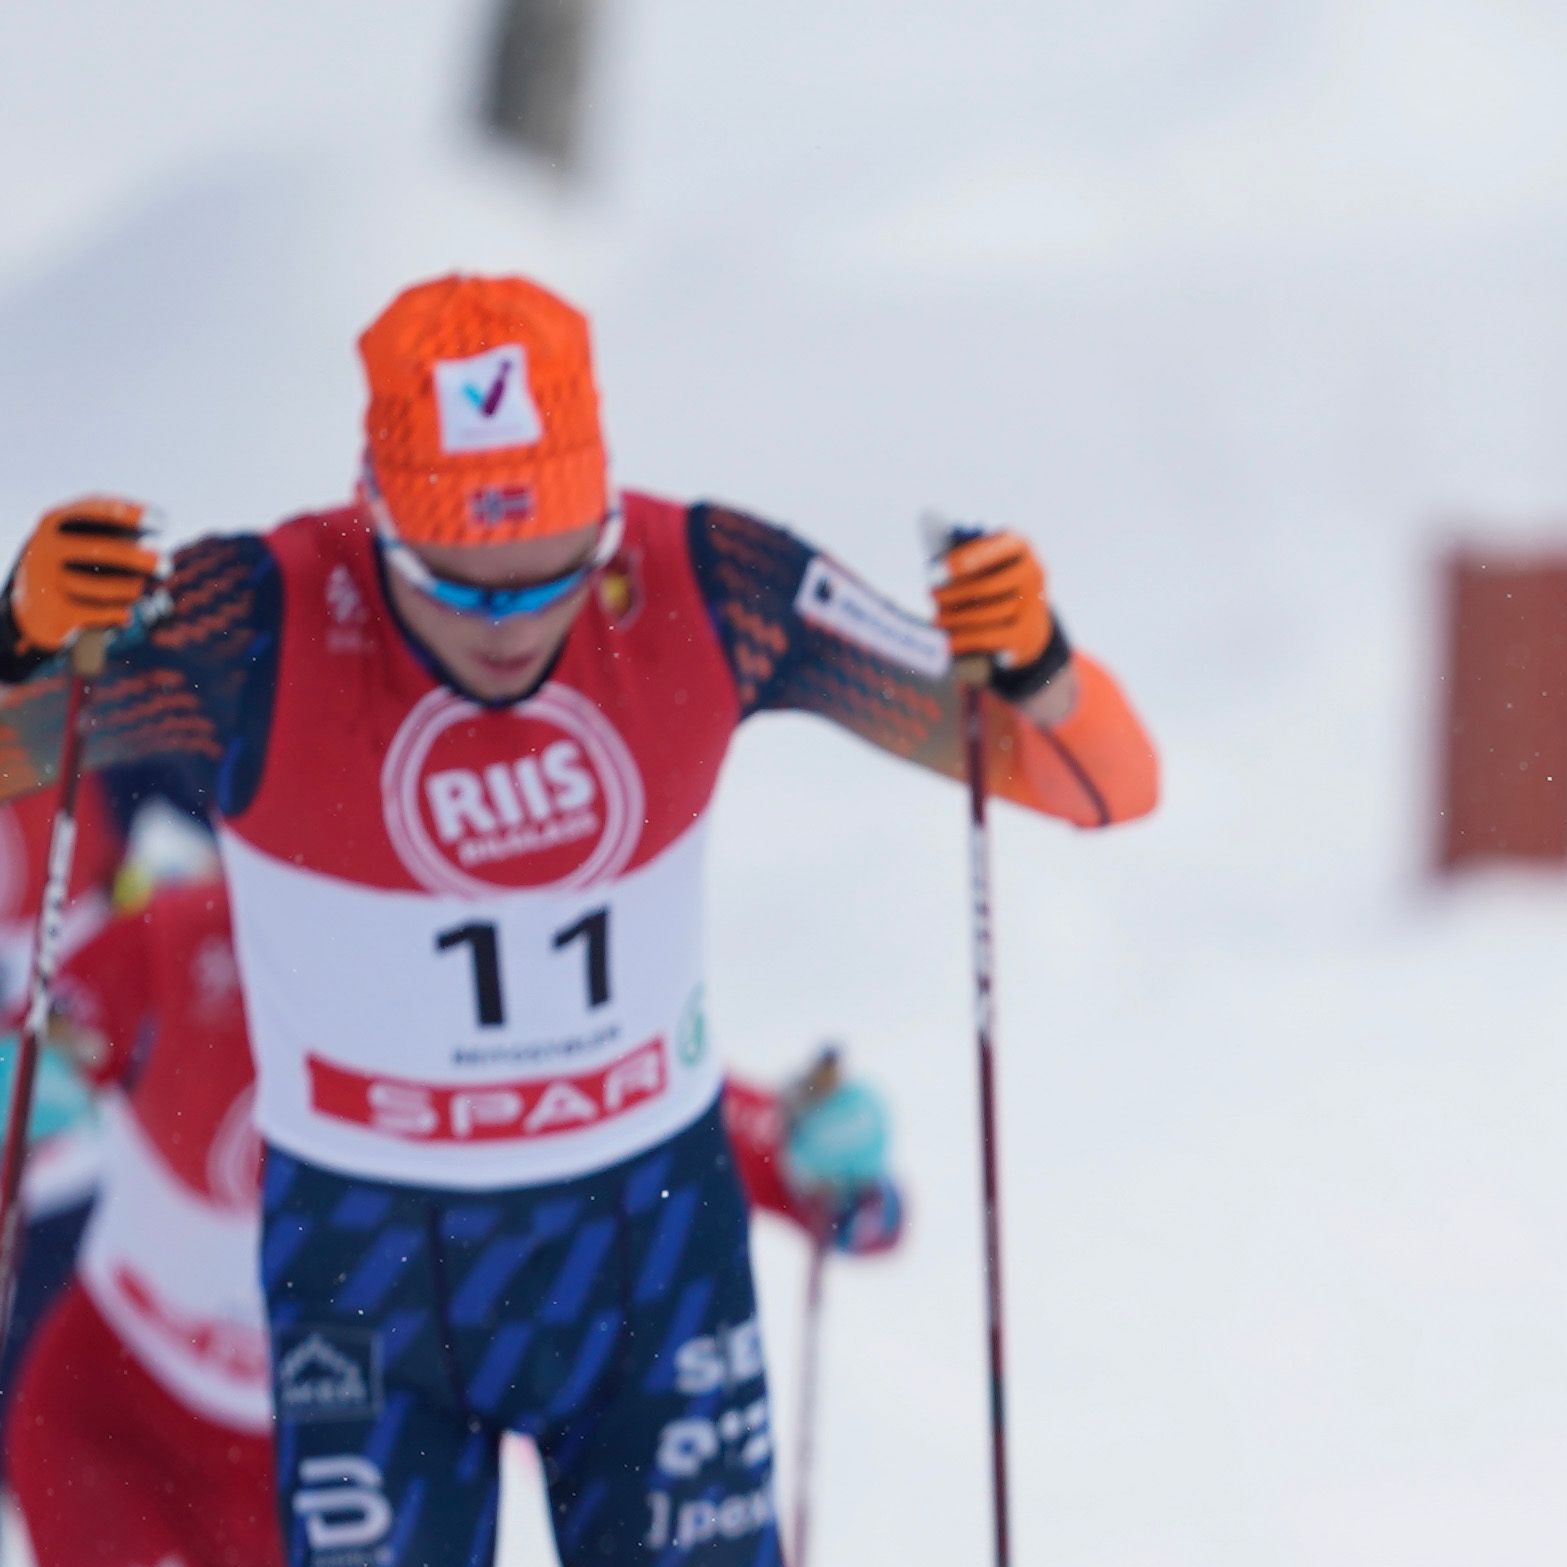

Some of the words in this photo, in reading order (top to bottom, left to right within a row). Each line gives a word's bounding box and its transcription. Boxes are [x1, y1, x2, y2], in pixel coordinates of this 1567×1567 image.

[427, 740, 596, 842] RIIS
[434, 906, 610, 1029] 11
[369, 1050, 661, 1138] SPAR
